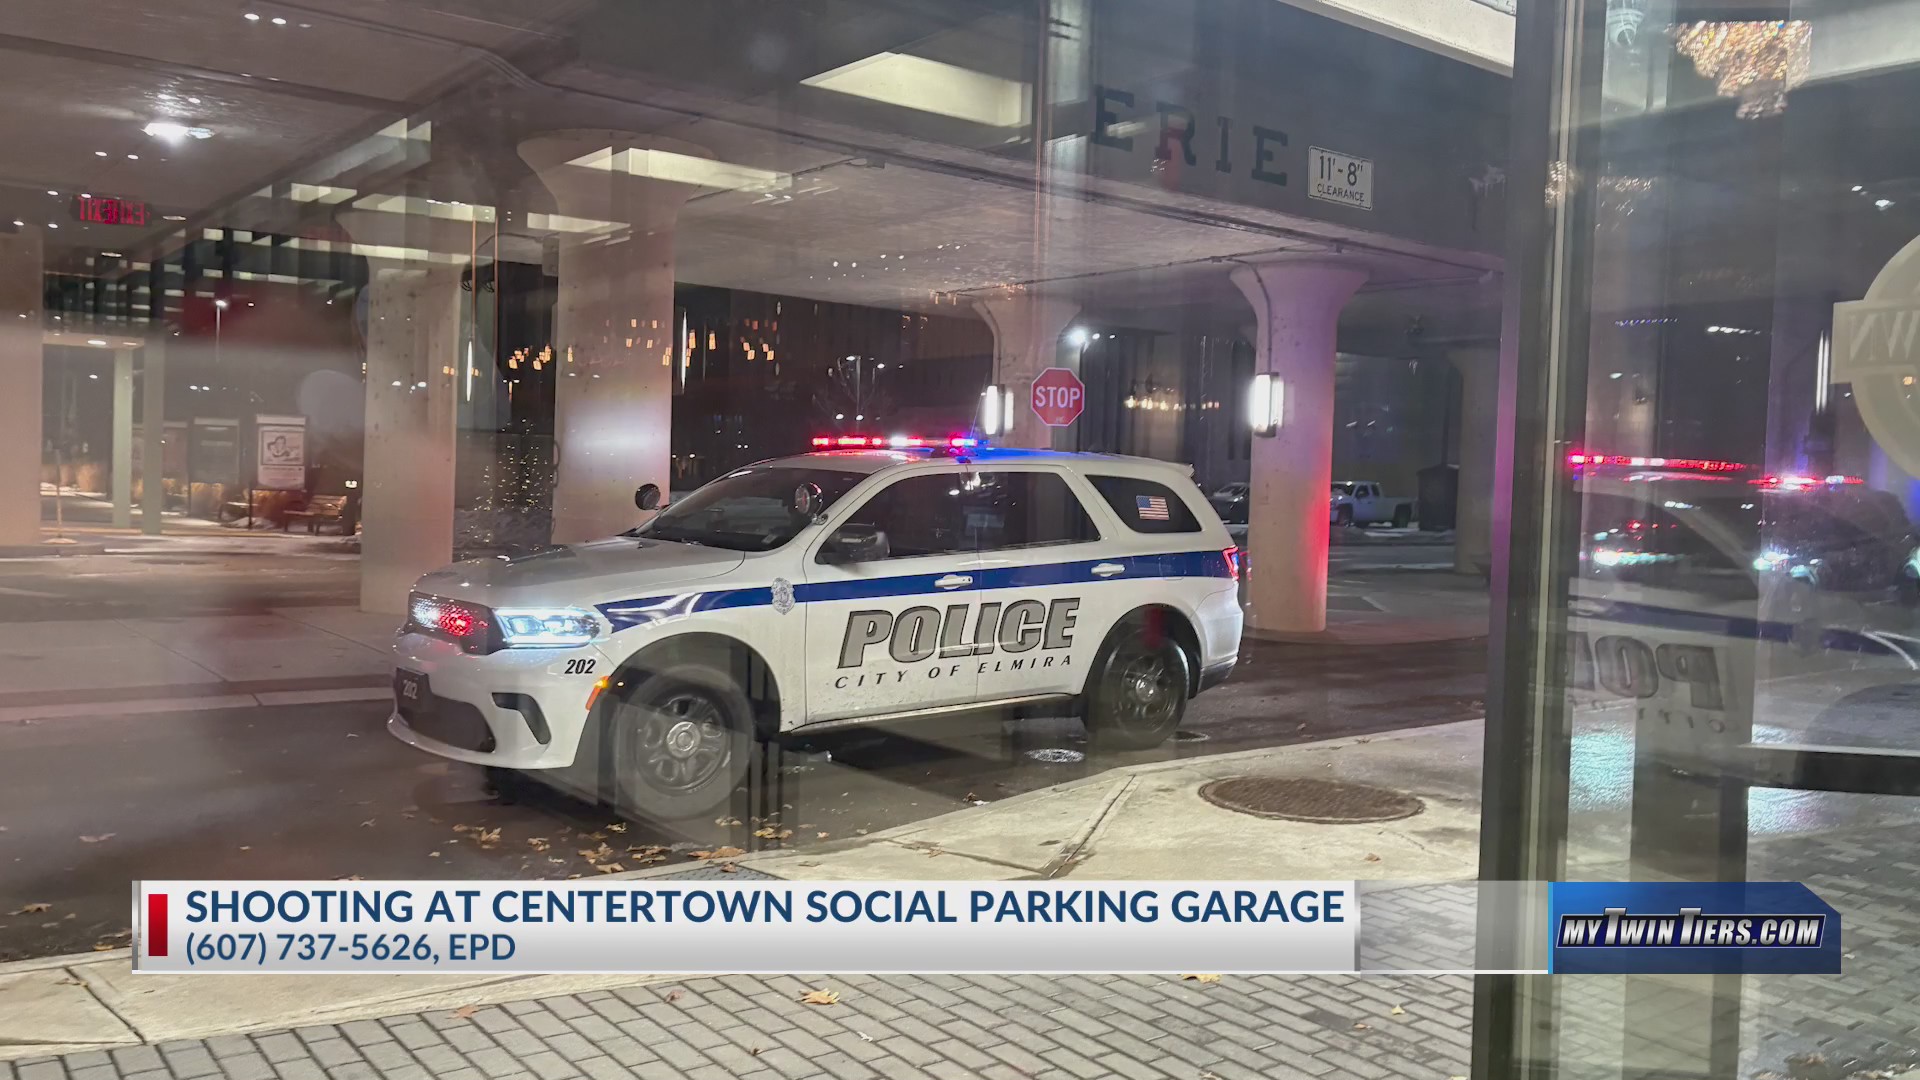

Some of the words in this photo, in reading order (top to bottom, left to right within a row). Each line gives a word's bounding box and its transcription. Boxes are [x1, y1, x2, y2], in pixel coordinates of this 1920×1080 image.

[1090, 85, 1288, 187] ERIE
[1317, 183, 1365, 202] CLEARANCE
[1035, 385, 1081, 408] STOP
[837, 597, 1081, 669] POLICE
[564, 659, 596, 675] 202
[835, 671, 908, 689] CITY
[928, 665, 960, 677] OF
[978, 655, 1071, 674] ELMIRA
